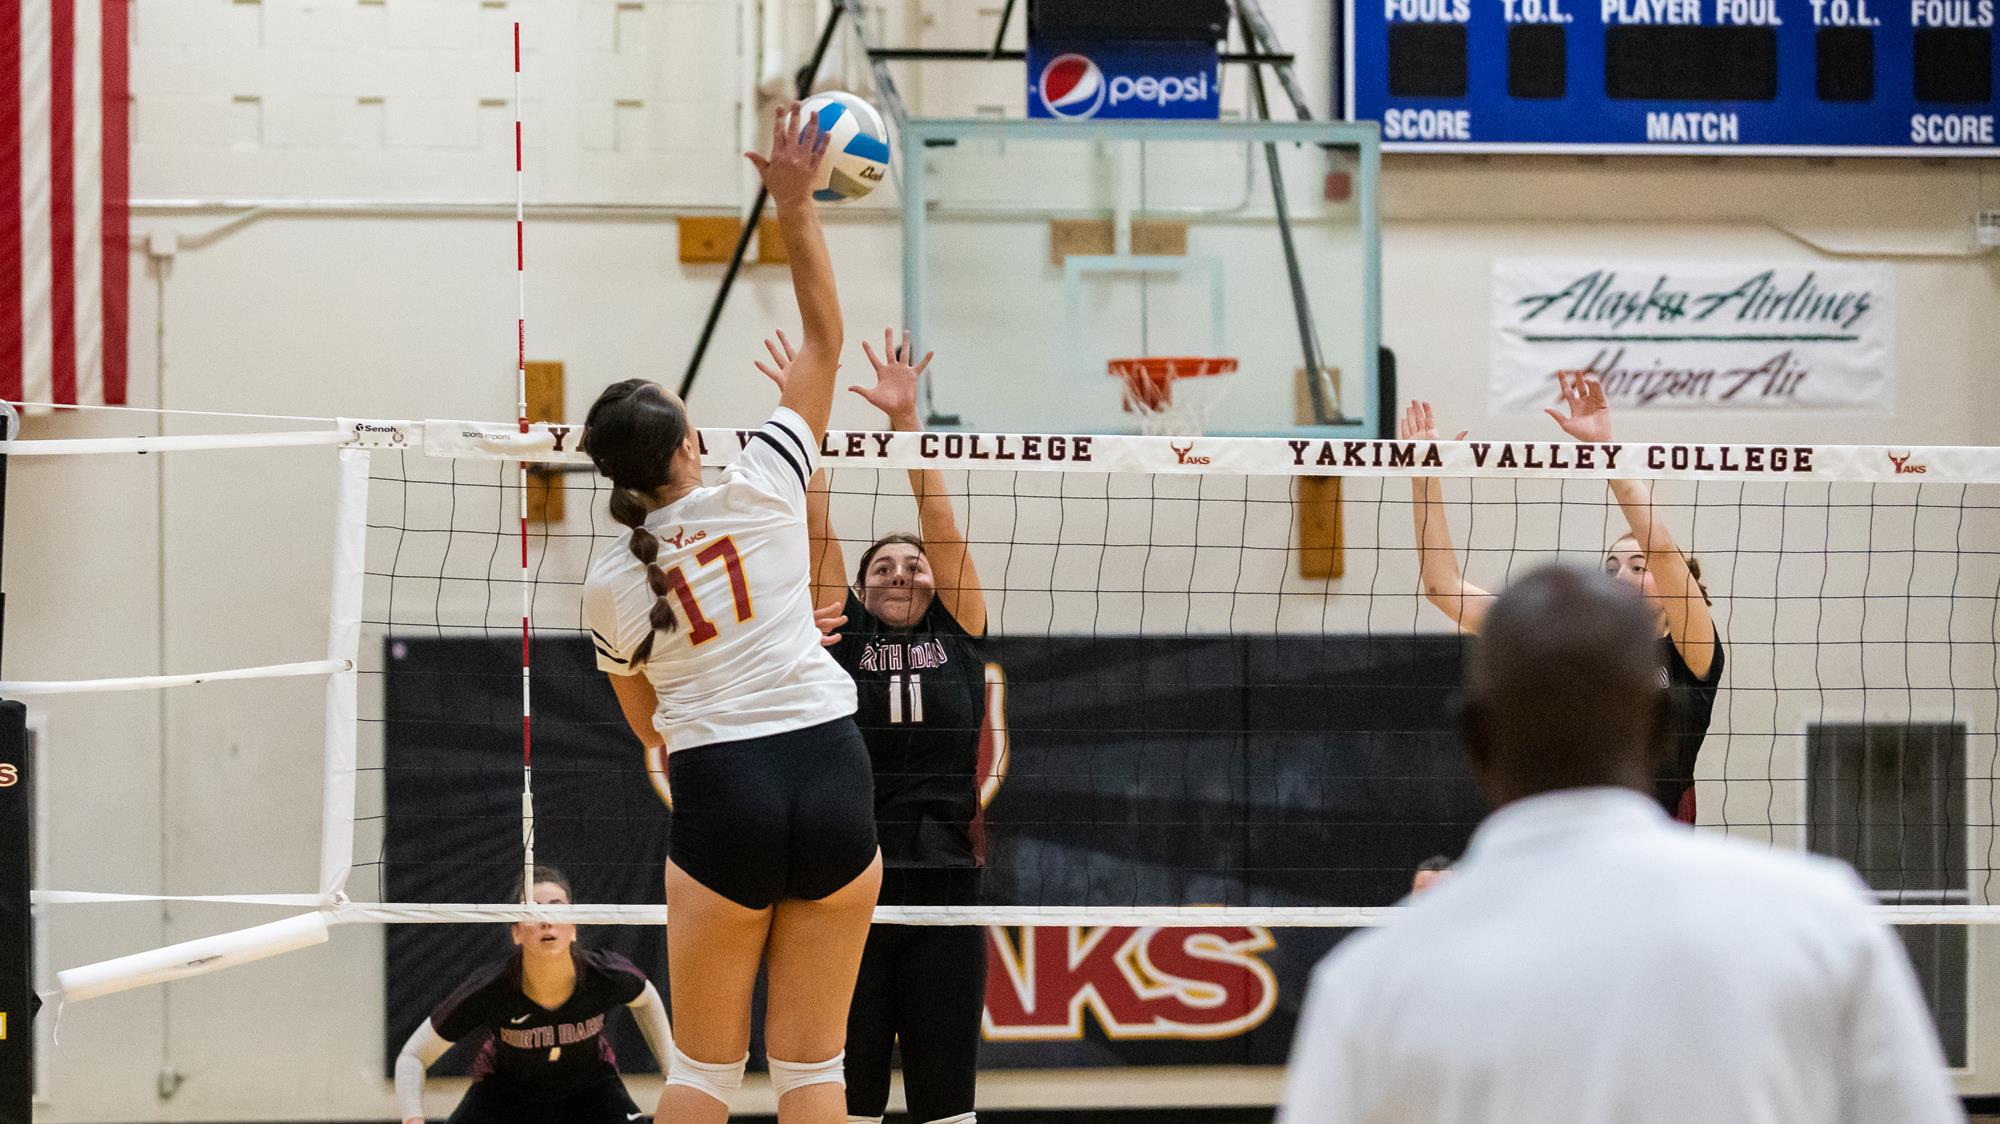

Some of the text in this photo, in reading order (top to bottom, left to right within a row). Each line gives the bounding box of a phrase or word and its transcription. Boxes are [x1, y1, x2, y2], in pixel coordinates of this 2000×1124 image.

[1384, 0, 1471, 22] FOULS
[1504, 0, 1574, 23] T.O.L.
[1600, 0, 1783, 25] PLAYER FOUL
[1810, 0, 1881, 26] T.O.L.
[1911, 0, 1994, 27] FOULS
[1109, 71, 1208, 107] pepsi
[1384, 108, 1471, 139] SCORE
[1646, 111, 1738, 142] MATCH
[1910, 114, 1994, 144] SCORE
[1516, 269, 1871, 328] Alaska Airlines
[1721, 349, 1809, 400] Air
[365, 424, 397, 433] Senoh
[736, 430, 894, 457] VLEY
[920, 433, 1092, 462] COLLEGE
[1288, 440, 1814, 472] YAKIMA VALLEY COLLEGE
[662, 533, 755, 647] 17
[889, 673, 923, 723] 11
